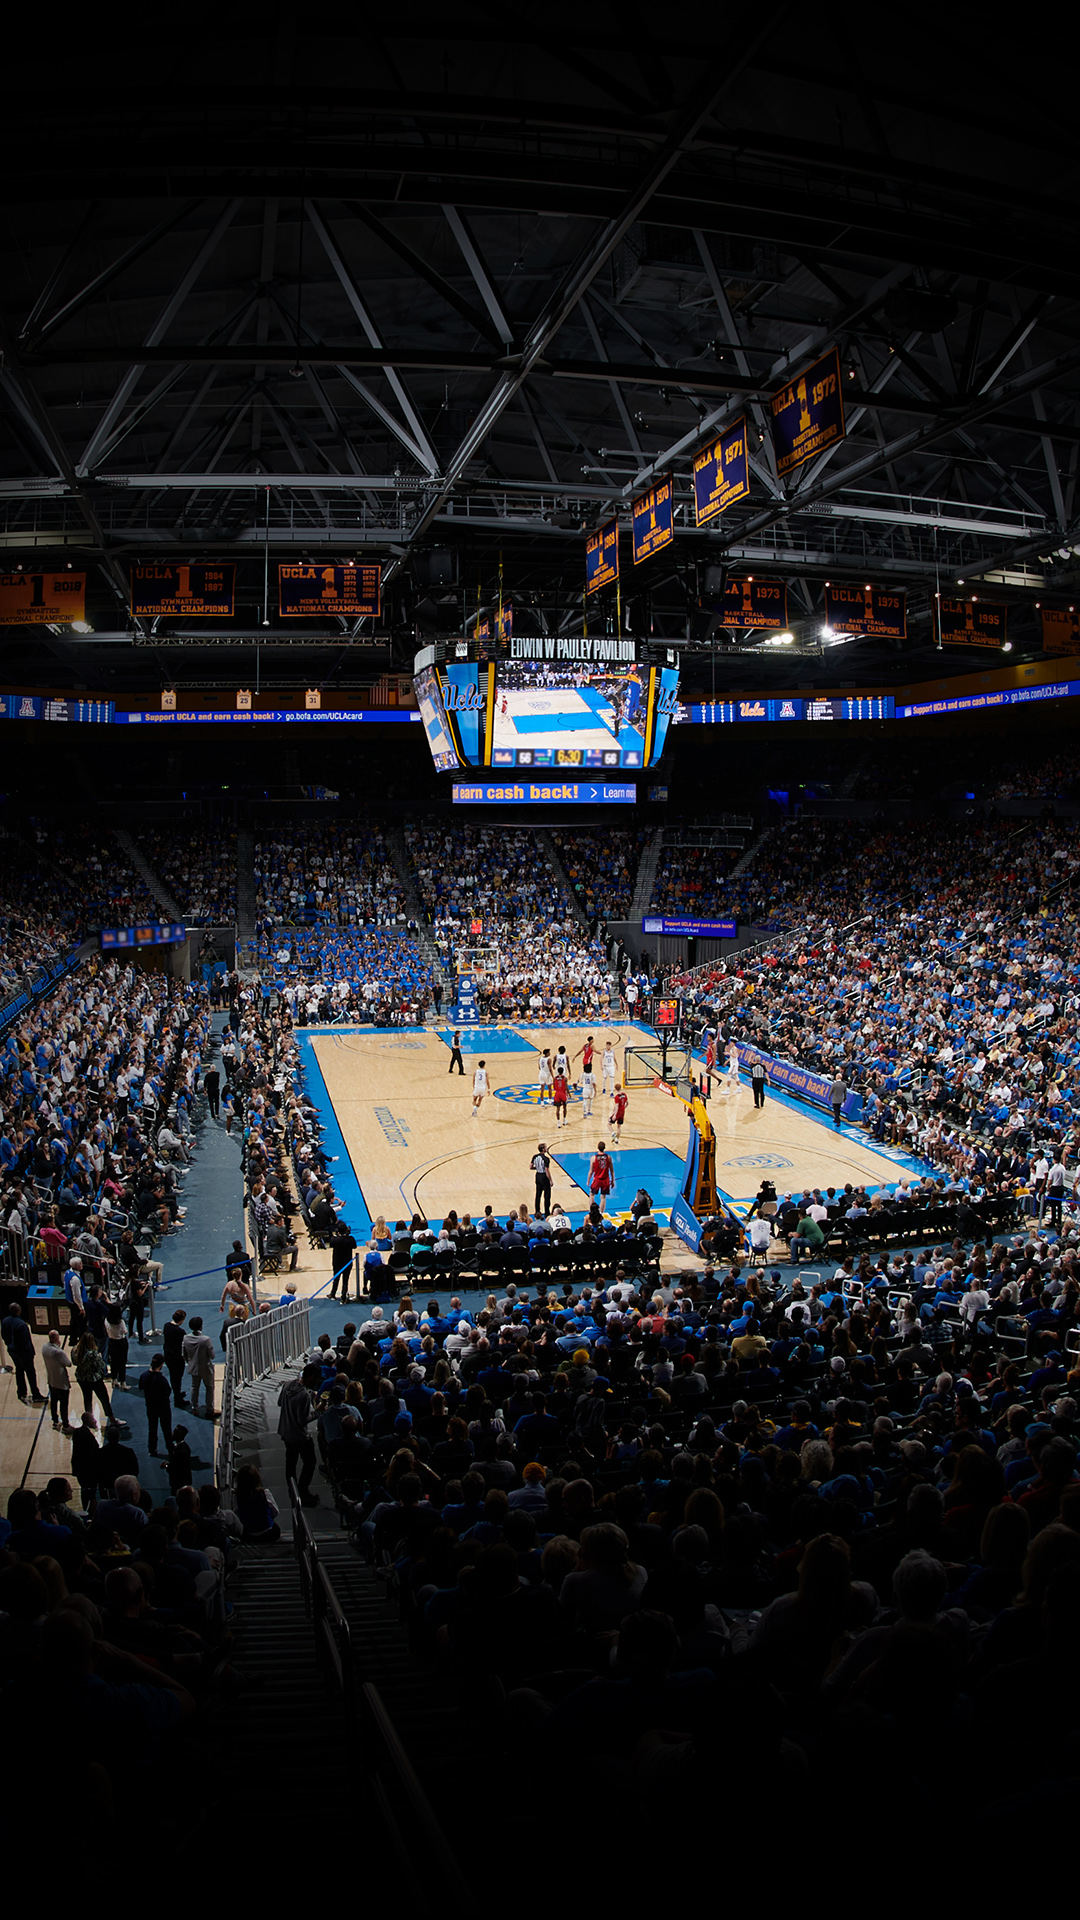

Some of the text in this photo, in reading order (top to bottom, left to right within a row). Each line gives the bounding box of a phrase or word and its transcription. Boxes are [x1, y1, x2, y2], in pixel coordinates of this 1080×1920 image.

[771, 373, 836, 432] UCLA 1 1972
[695, 448, 713, 472] UCLA
[725, 439, 743, 465] 1971
[634, 495, 650, 518] UCLA
[0, 575, 81, 606] CLA 1 2018
[136, 566, 223, 597] UCLA 1 1984
[205, 583, 223, 591] 1987
[282, 568, 317, 579] UCLA
[321, 568, 338, 598] 1
[741, 583, 753, 611] 1
[756, 587, 780, 599] 1973
[831, 589, 900, 619] UCLA 1 1975
[136, 605, 229, 613] NATIONAL CHAMPIONS
[964, 603, 974, 630] 1
[979, 613, 1000, 626] 1995
[1044, 611, 1069, 623] UCLA
[744, 617, 780, 626] CHAMPIONS
[833, 622, 900, 635] NATIONAL CHAMPIONS
[511, 638, 635, 661] EDWIN W PAULEY PAVILION
[441, 683, 485, 710] Ucla
[913, 705, 933, 715] Support
[933, 702, 947, 712] UCLA
[947, 700, 958, 710] and
[958, 700, 971, 708] earn
[972, 697, 986, 707] cash
[986, 694, 1004, 705] back!
[145, 713, 175, 722] Support
[177, 713, 196, 721] UCLA
[253, 712, 274, 720] back!
[286, 712, 363, 721] go.bofa.com/UCLAcard
[740, 702, 765, 717] Ucla
[460, 788, 483, 799] earn
[486, 785, 524, 799] cash
[530, 785, 579, 799] back!
[603, 786, 625, 798] Learn
[773, 1065, 789, 1079] earn
[788, 1073, 806, 1087] cash
[806, 1078, 830, 1098] back!
[555, 1218, 567, 1228] 28
